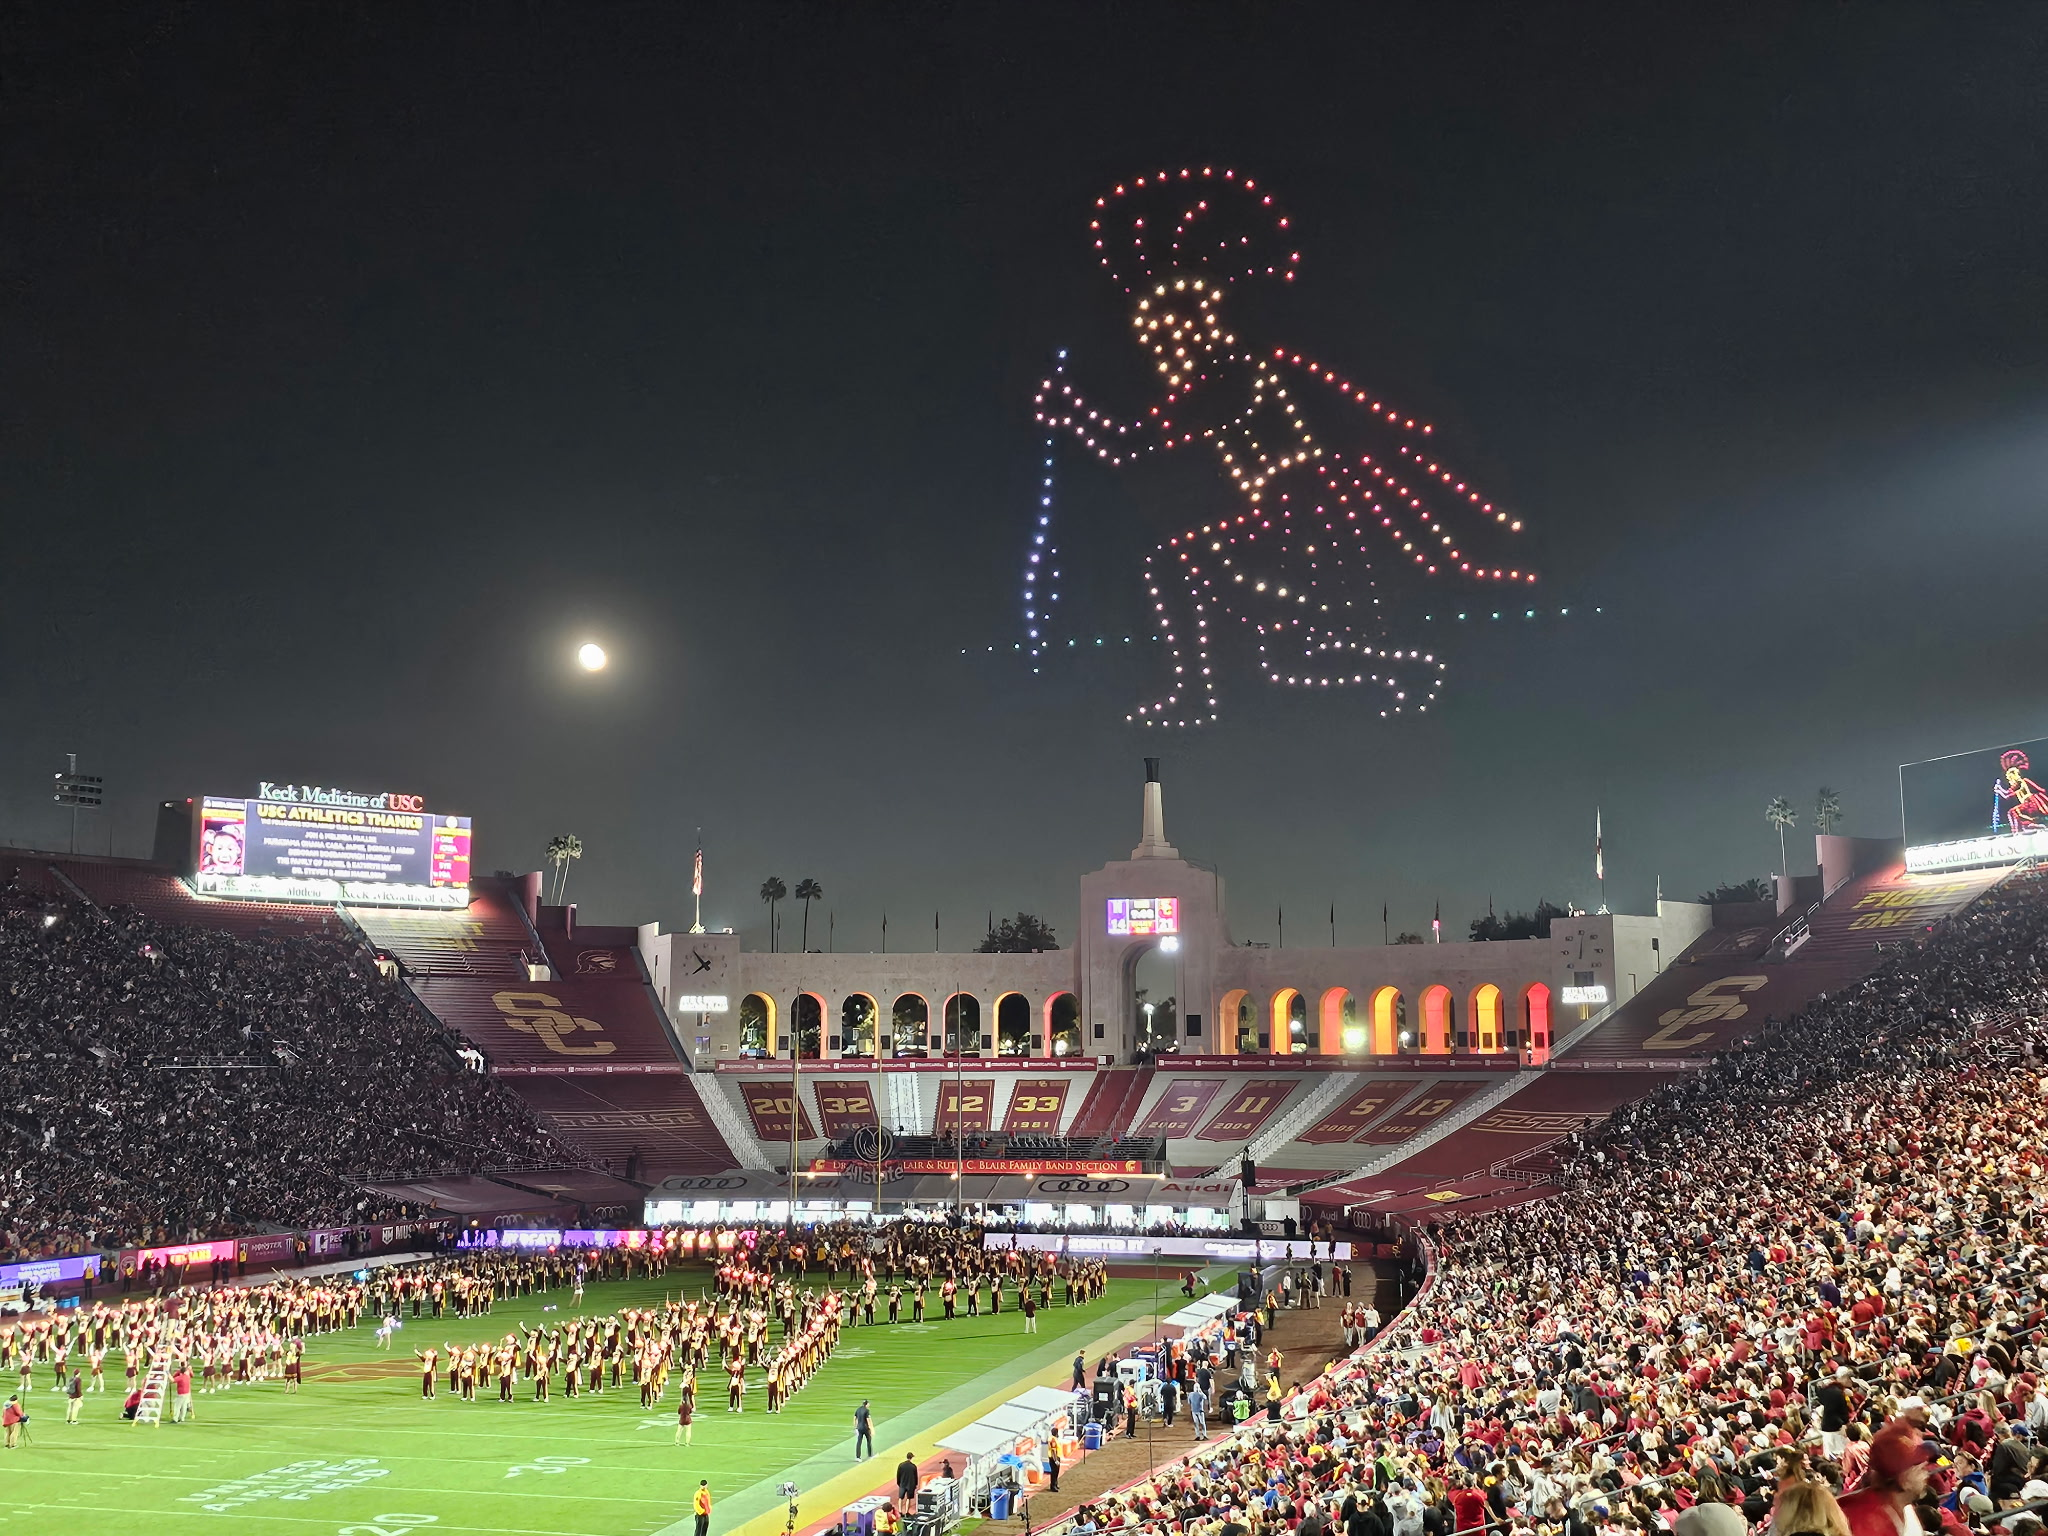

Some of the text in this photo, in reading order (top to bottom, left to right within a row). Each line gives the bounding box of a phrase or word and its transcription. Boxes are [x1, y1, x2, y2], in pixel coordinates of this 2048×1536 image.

[259, 782, 424, 811] Keck Medicine of USC
[257, 804, 287, 819] USC
[288, 806, 365, 825] ATHLETICS
[365, 813, 424, 830] THANKS
[1851, 884, 1969, 909] FIGHT
[491, 991, 617, 1055] SC
[751, 1098, 798, 1115] 20
[823, 1097, 871, 1113] 32
[946, 1096, 984, 1112] 12
[1014, 1096, 1059, 1112] 33
[1169, 1096, 1198, 1112] 3
[1234, 1096, 1271, 1113] 11
[1350, 1098, 1385, 1115] 5
[1404, 1099, 1453, 1115] 13
[1213, 1122, 1253, 1130] 2004
[1317, 1124, 1356, 1132] 2005
[844, 1163, 904, 1184] Allstate
[897, 1160, 924, 1169] LAIR
[926, 1160, 934, 1169] &
[966, 1161, 976, 1170] C.
[979, 1161, 1006, 1170] BLAIR
[1009, 1161, 1042, 1170] FAMILY
[1045, 1161, 1073, 1171] BAND
[1076, 1161, 1118, 1171] SECTION
[1160, 1183, 1231, 1192] Audi
[1320, 1210, 1338, 1220] Audi
[251, 1241, 282, 1251] MONSTER
[507, 1455, 592, 1475] 30
[175, 1460, 329, 1502] UNITED
[200, 1458, 380, 1512] AIRLINES
[278, 1468, 391, 1501] FIELD
